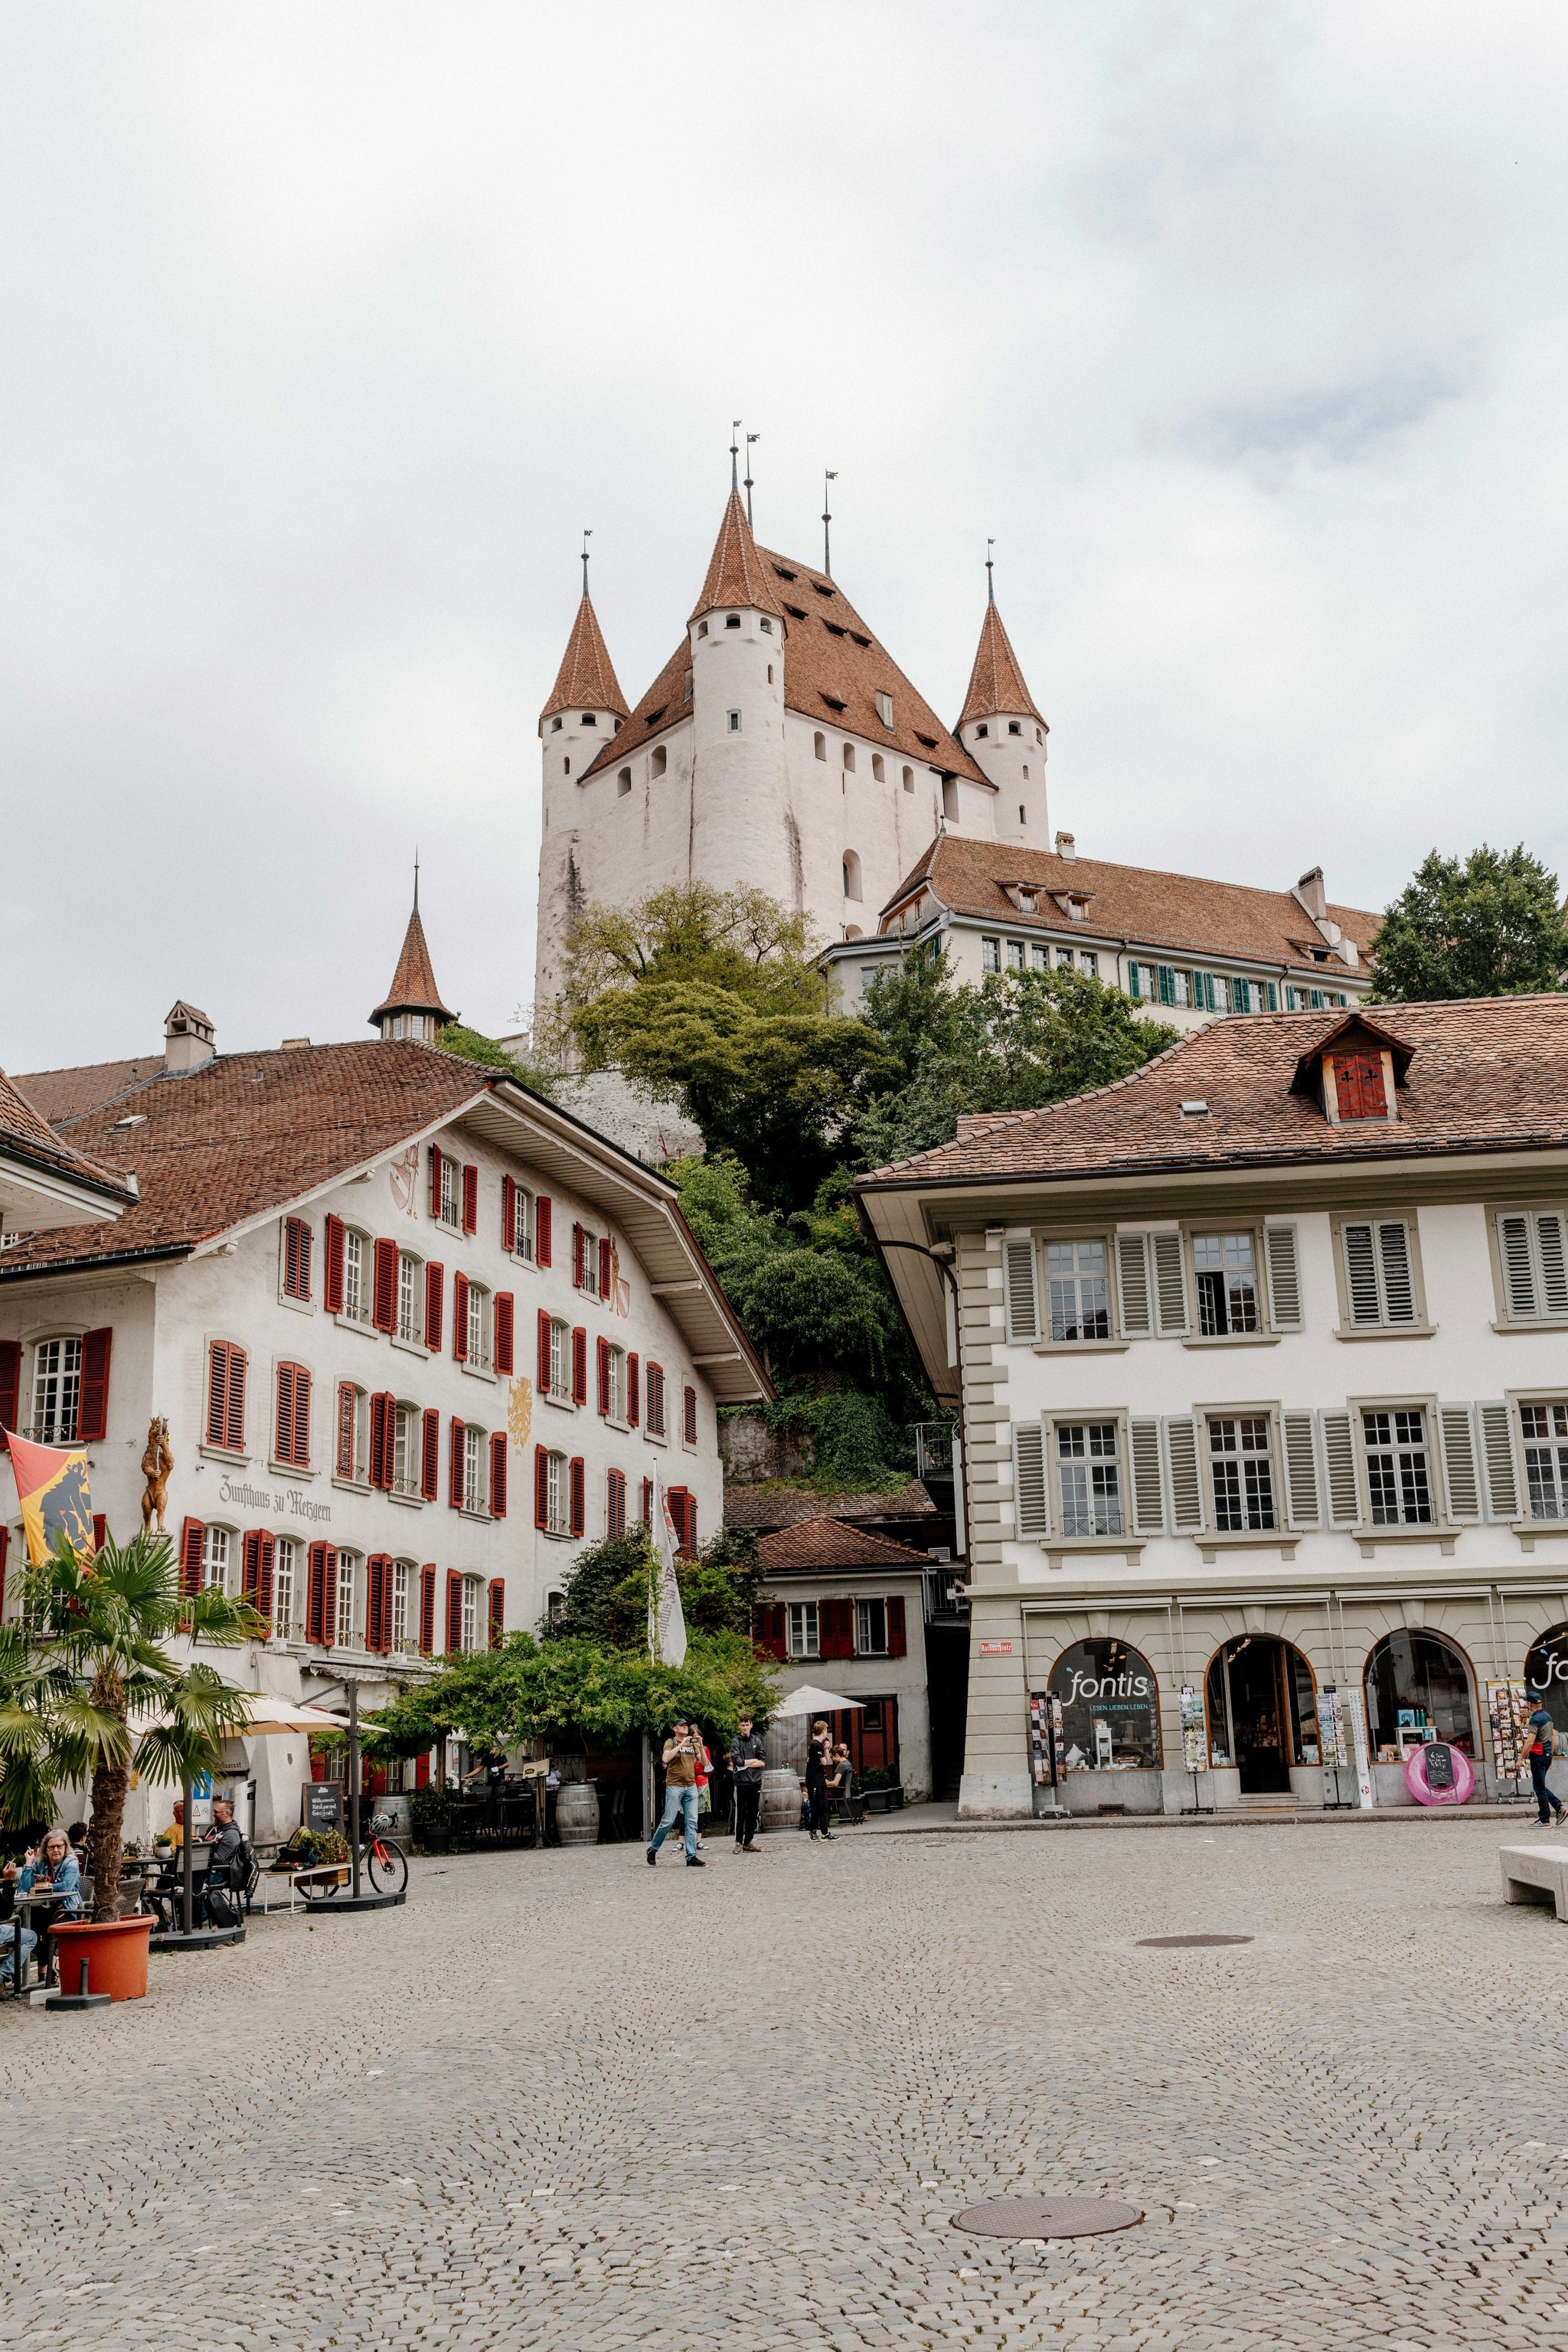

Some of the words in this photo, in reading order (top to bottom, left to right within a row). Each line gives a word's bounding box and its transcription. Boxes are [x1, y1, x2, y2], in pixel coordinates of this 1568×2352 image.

[219, 1474, 270, 1508] Zunfthaus
[273, 1494, 284, 1513] zu
[287, 1490, 331, 1521] Metzgern
[1062, 1671, 1148, 1707] fontis
